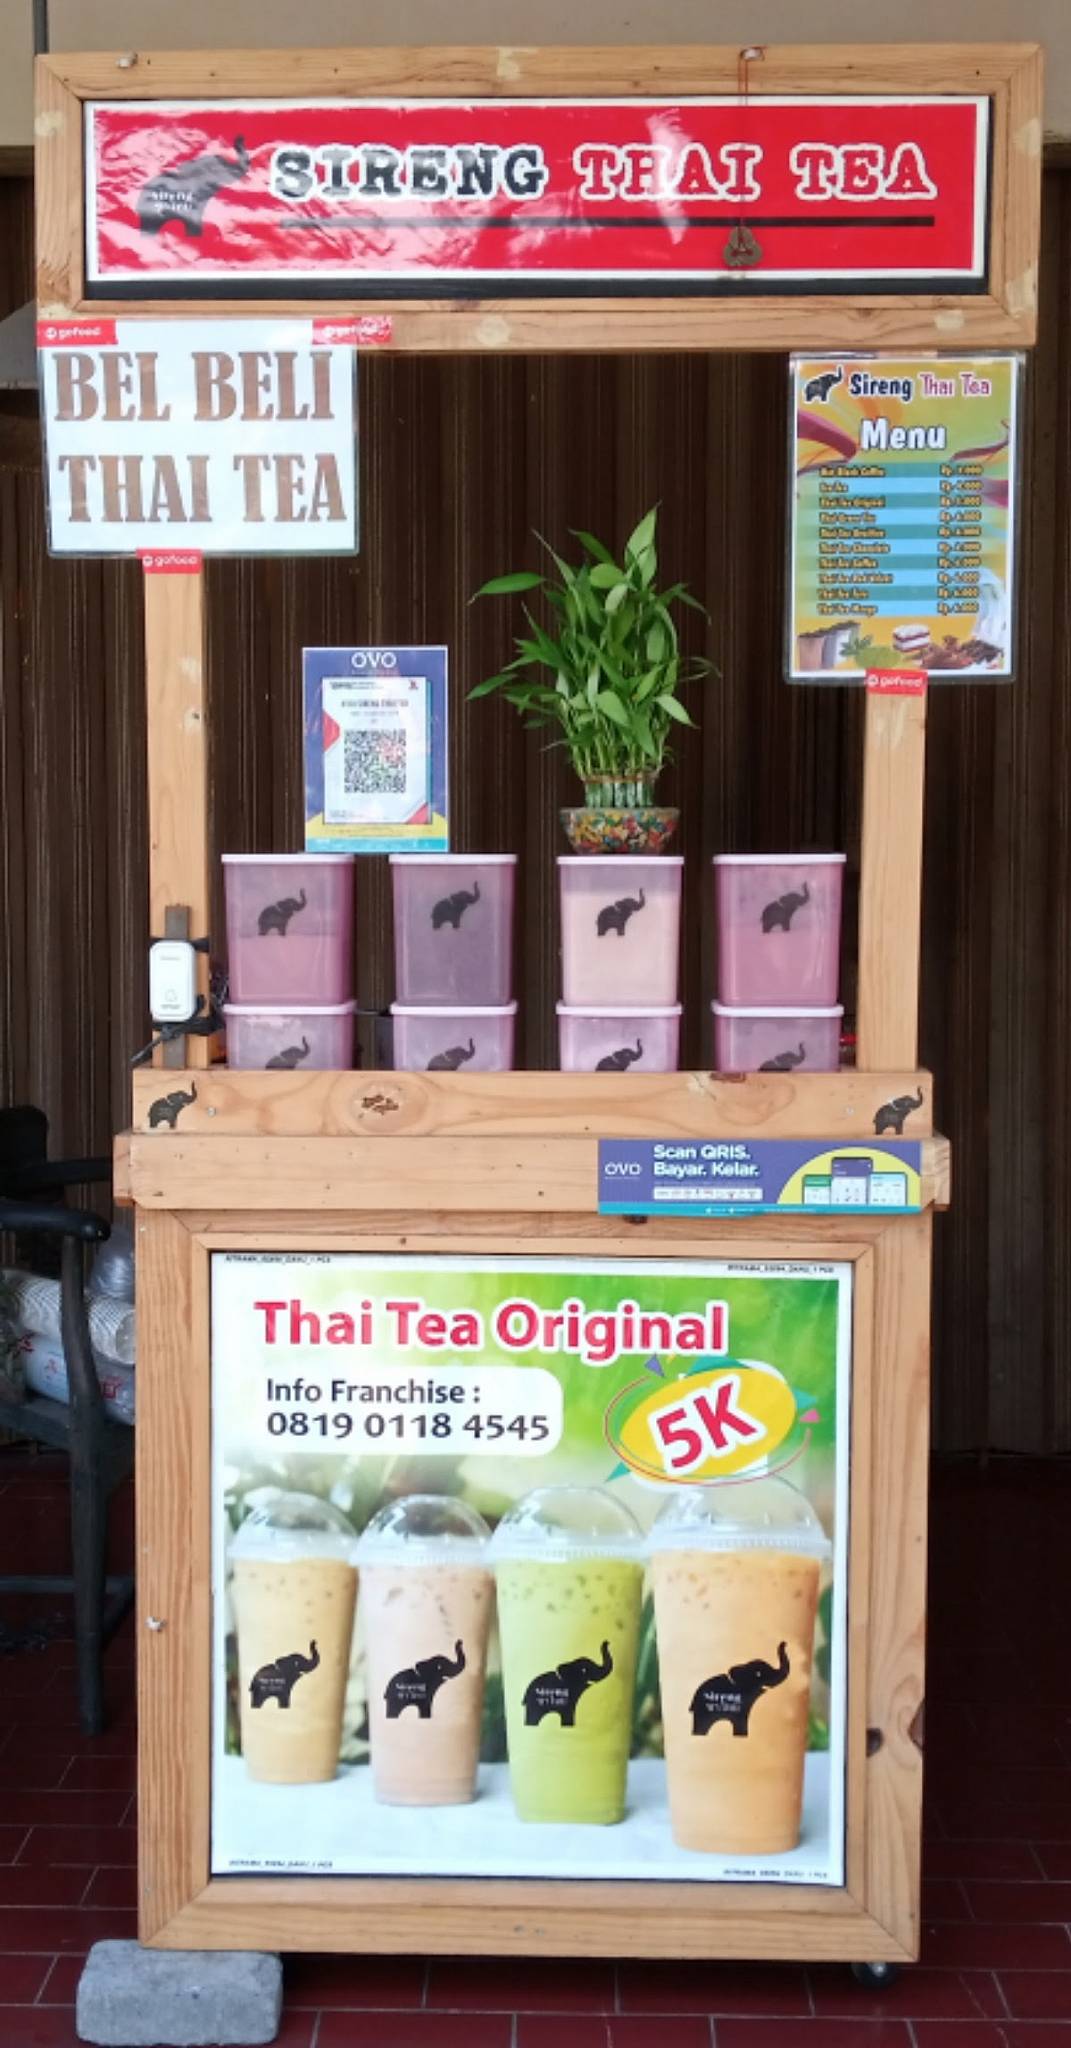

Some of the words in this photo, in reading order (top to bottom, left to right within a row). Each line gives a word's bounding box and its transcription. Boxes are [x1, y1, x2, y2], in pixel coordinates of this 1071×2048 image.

[272, 144, 547, 199] SIRENG
[573, 143, 762, 200] THAI
[789, 143, 938, 200] TEA
[52, 351, 171, 422] BEL
[191, 351, 335, 422] BELI
[850, 373, 913, 402] Sireng
[920, 373, 954, 396] Thai
[959, 373, 991, 396] Tea
[860, 417, 948, 451] Menu
[58, 454, 213, 523] THAI
[233, 453, 347, 522] TEA
[351, 651, 397, 668] OVO
[653, 1144, 697, 1159] Scan
[701, 1144, 751, 1159] QRIS.
[604, 1162, 641, 1176] OVO
[653, 1161, 707, 1180] Bayar.
[712, 1161, 760, 1176] Kelar.
[253, 1299, 373, 1346] Thai
[385, 1301, 480, 1347] Tea
[496, 1302, 724, 1362] Original
[267, 1378, 322, 1403] Info
[331, 1378, 466, 1405] Franchise
[266, 1411, 353, 1439] 0819
[364, 1411, 451, 1439] 0118
[462, 1413, 550, 1441] 4545
[655, 1381, 758, 1469] 5K
